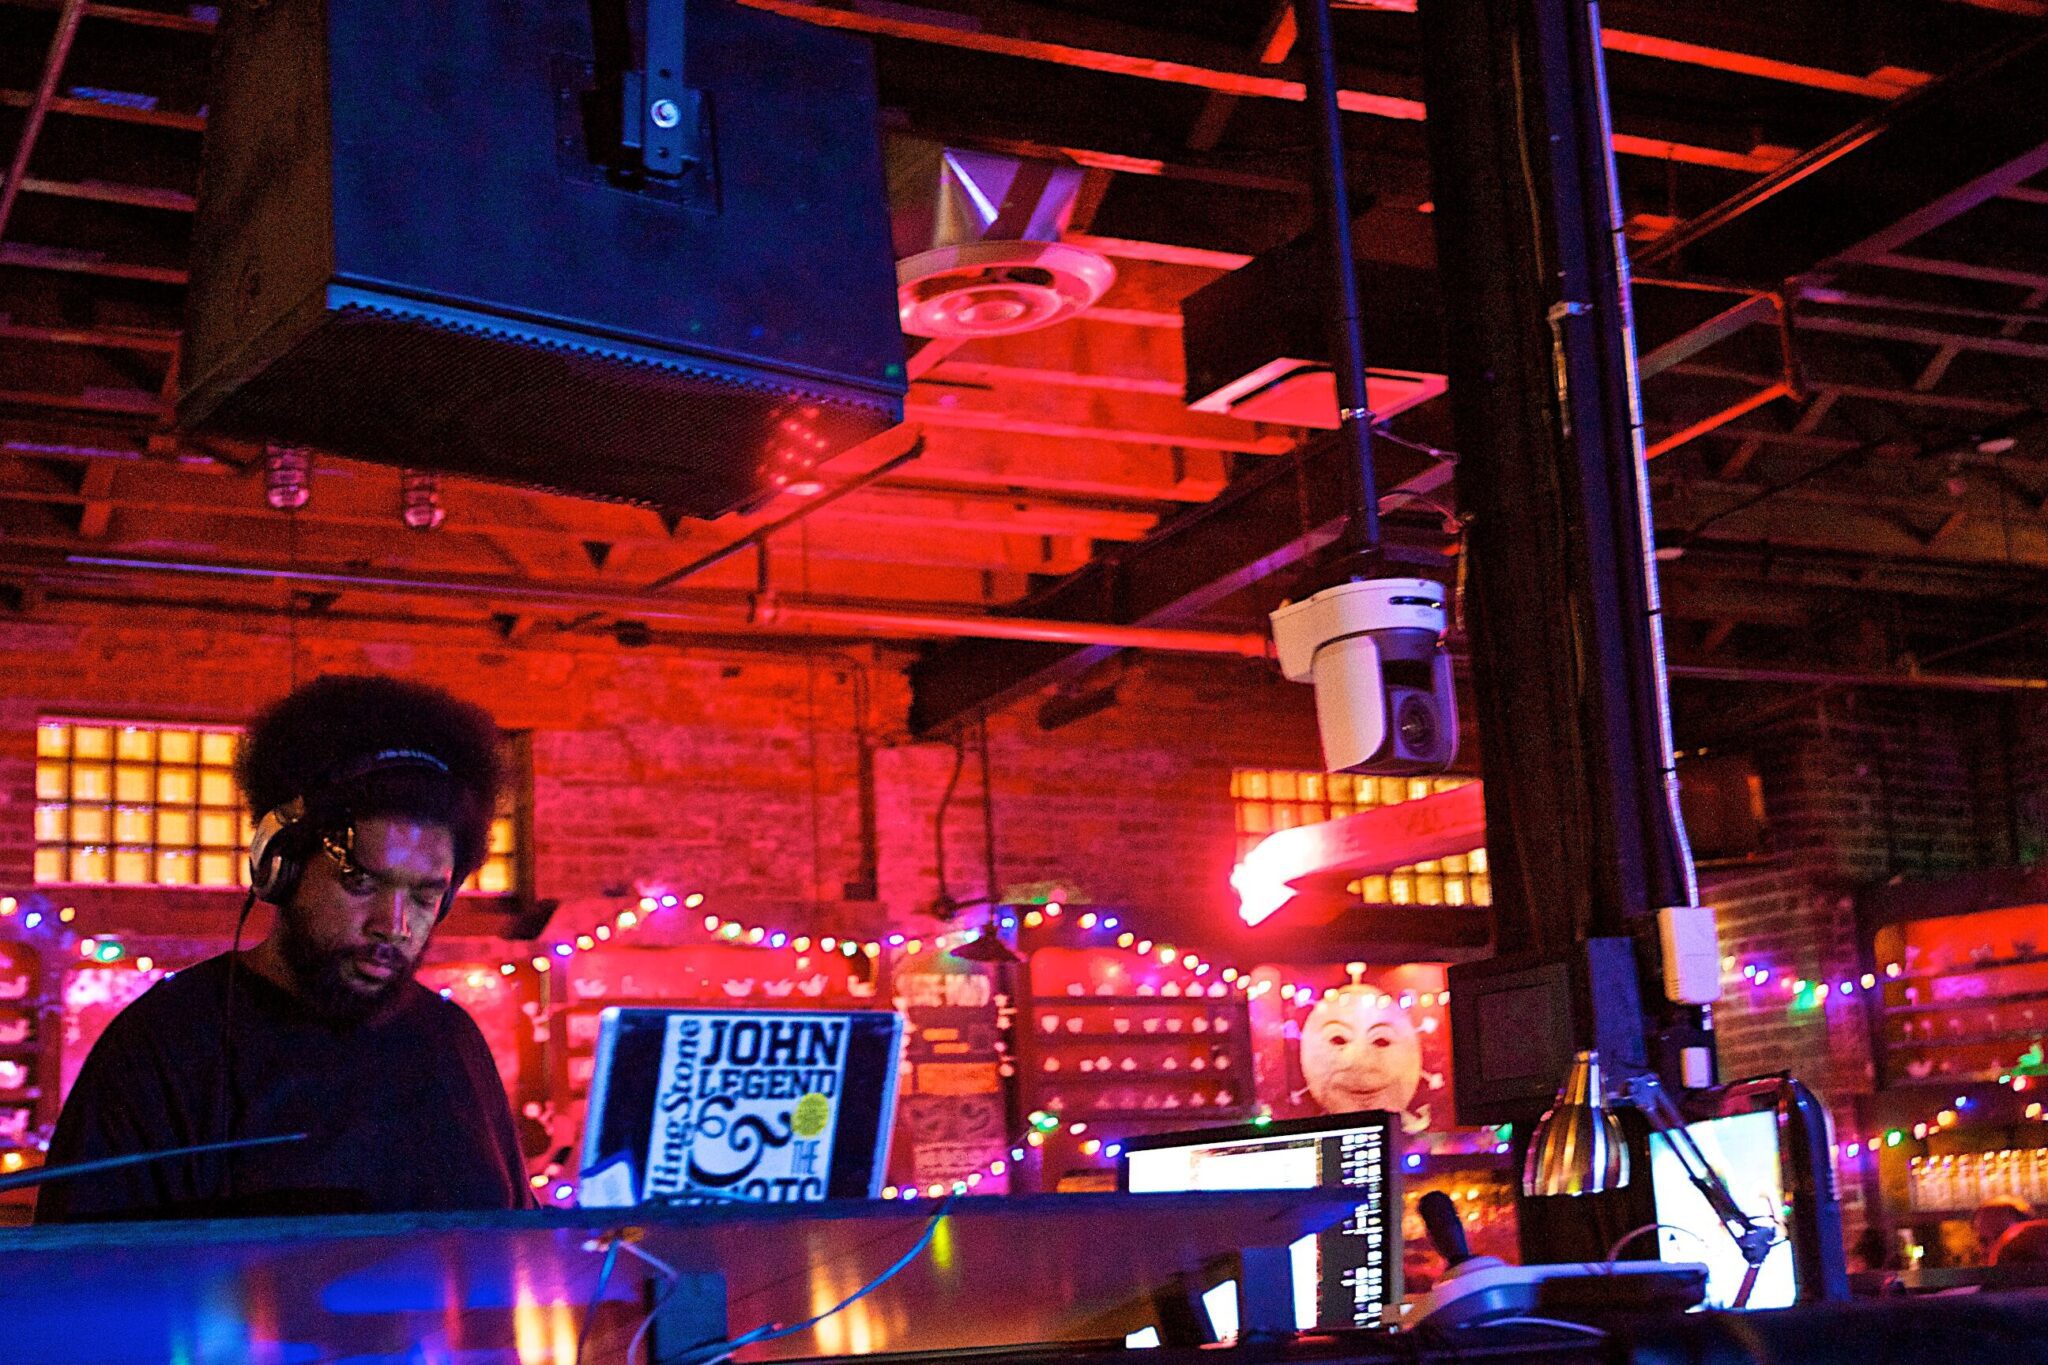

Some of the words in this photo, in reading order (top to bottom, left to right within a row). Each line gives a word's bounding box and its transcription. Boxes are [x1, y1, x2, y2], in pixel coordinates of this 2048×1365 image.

[701, 1020, 845, 1066] JOHN
[652, 1019, 701, 1187] lingStone
[696, 1068, 838, 1100] LEGEND
